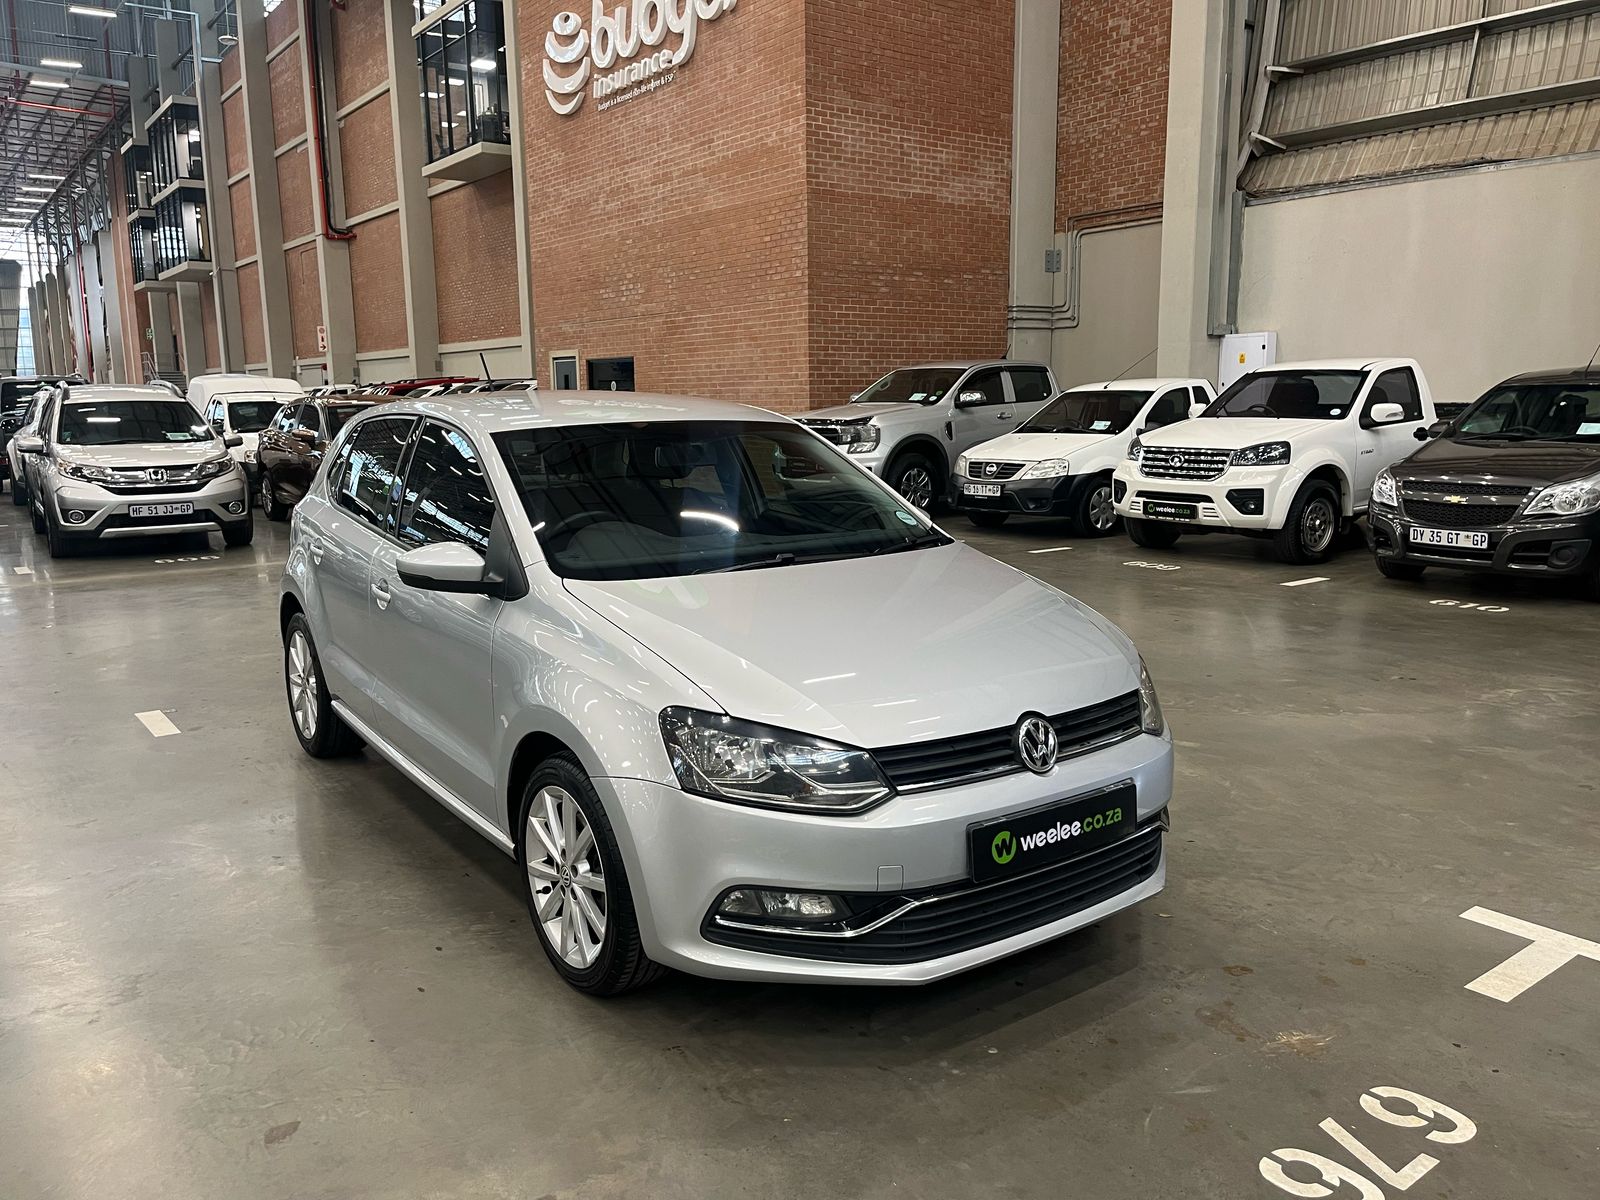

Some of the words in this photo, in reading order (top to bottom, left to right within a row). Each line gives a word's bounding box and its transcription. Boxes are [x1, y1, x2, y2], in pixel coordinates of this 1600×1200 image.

[593, 49, 673, 98] insurance
[981, 485, 988, 494] TT
[992, 486, 1000, 494] GP
[132, 506, 143, 516] HF
[148, 506, 159, 515] 51
[163, 505, 174, 514] JJ
[180, 504, 191, 513] GP
[1155, 506, 1191, 515] weelee.co.za
[1412, 528, 1425, 542] DY
[1429, 530, 1442, 543] 35
[1447, 532, 1460, 545] GT
[1472, 534, 1487, 547] GP
[1020, 807, 1122, 853] weelee.co.za
